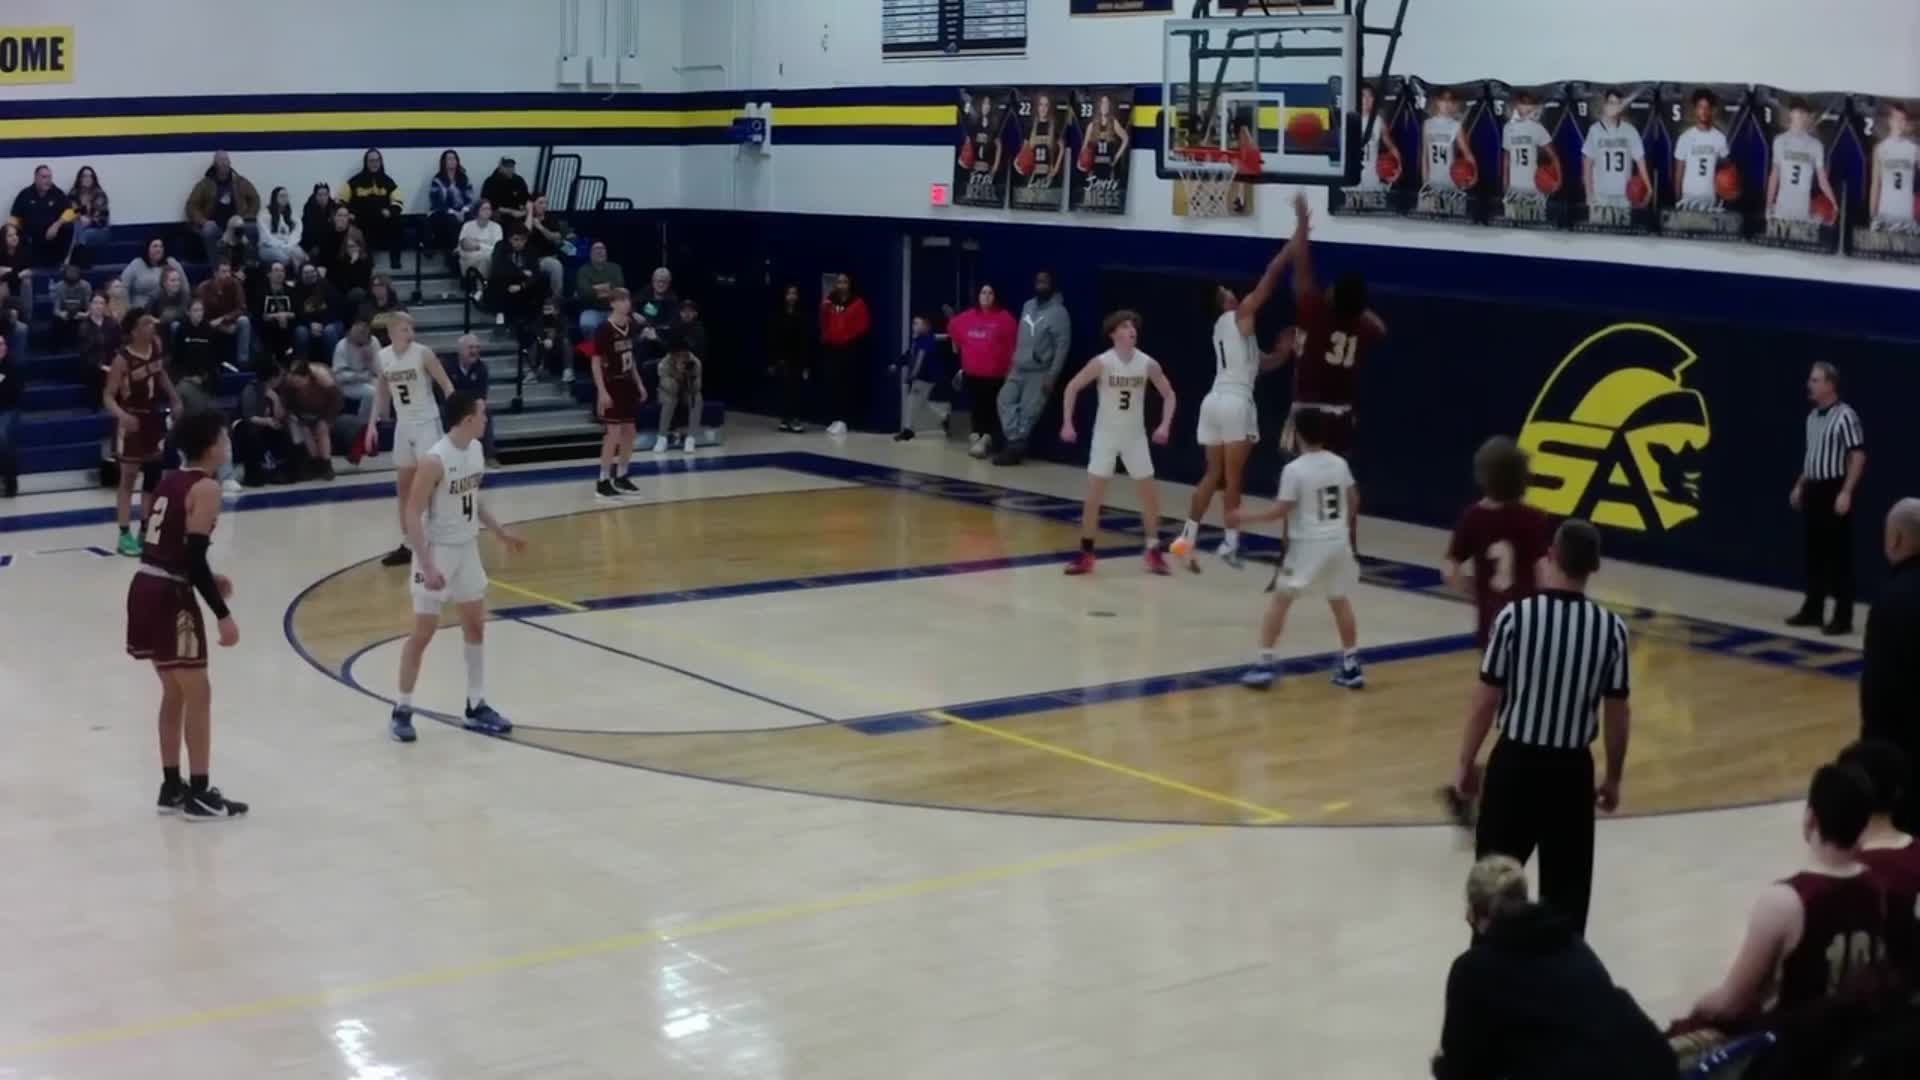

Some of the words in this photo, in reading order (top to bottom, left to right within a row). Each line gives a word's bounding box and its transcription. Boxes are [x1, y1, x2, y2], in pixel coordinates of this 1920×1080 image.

[0, 36, 65, 73] OME
[1018, 101, 1032, 117] 22
[1671, 104, 1681, 121] 5
[1863, 117, 1875, 136] 2
[1431, 143, 1448, 165] 24
[1515, 148, 1529, 166] 15
[1604, 151, 1625, 172] 13
[1698, 157, 1708, 177] 5
[1219, 340, 1227, 368] 1
[1325, 330, 1358, 367] 31
[397, 384, 411, 405] 2
[1119, 390, 1131, 411] 3
[462, 492, 473, 522] 4
[1317, 486, 1341, 521] 13
[145, 496, 168, 545] 2
